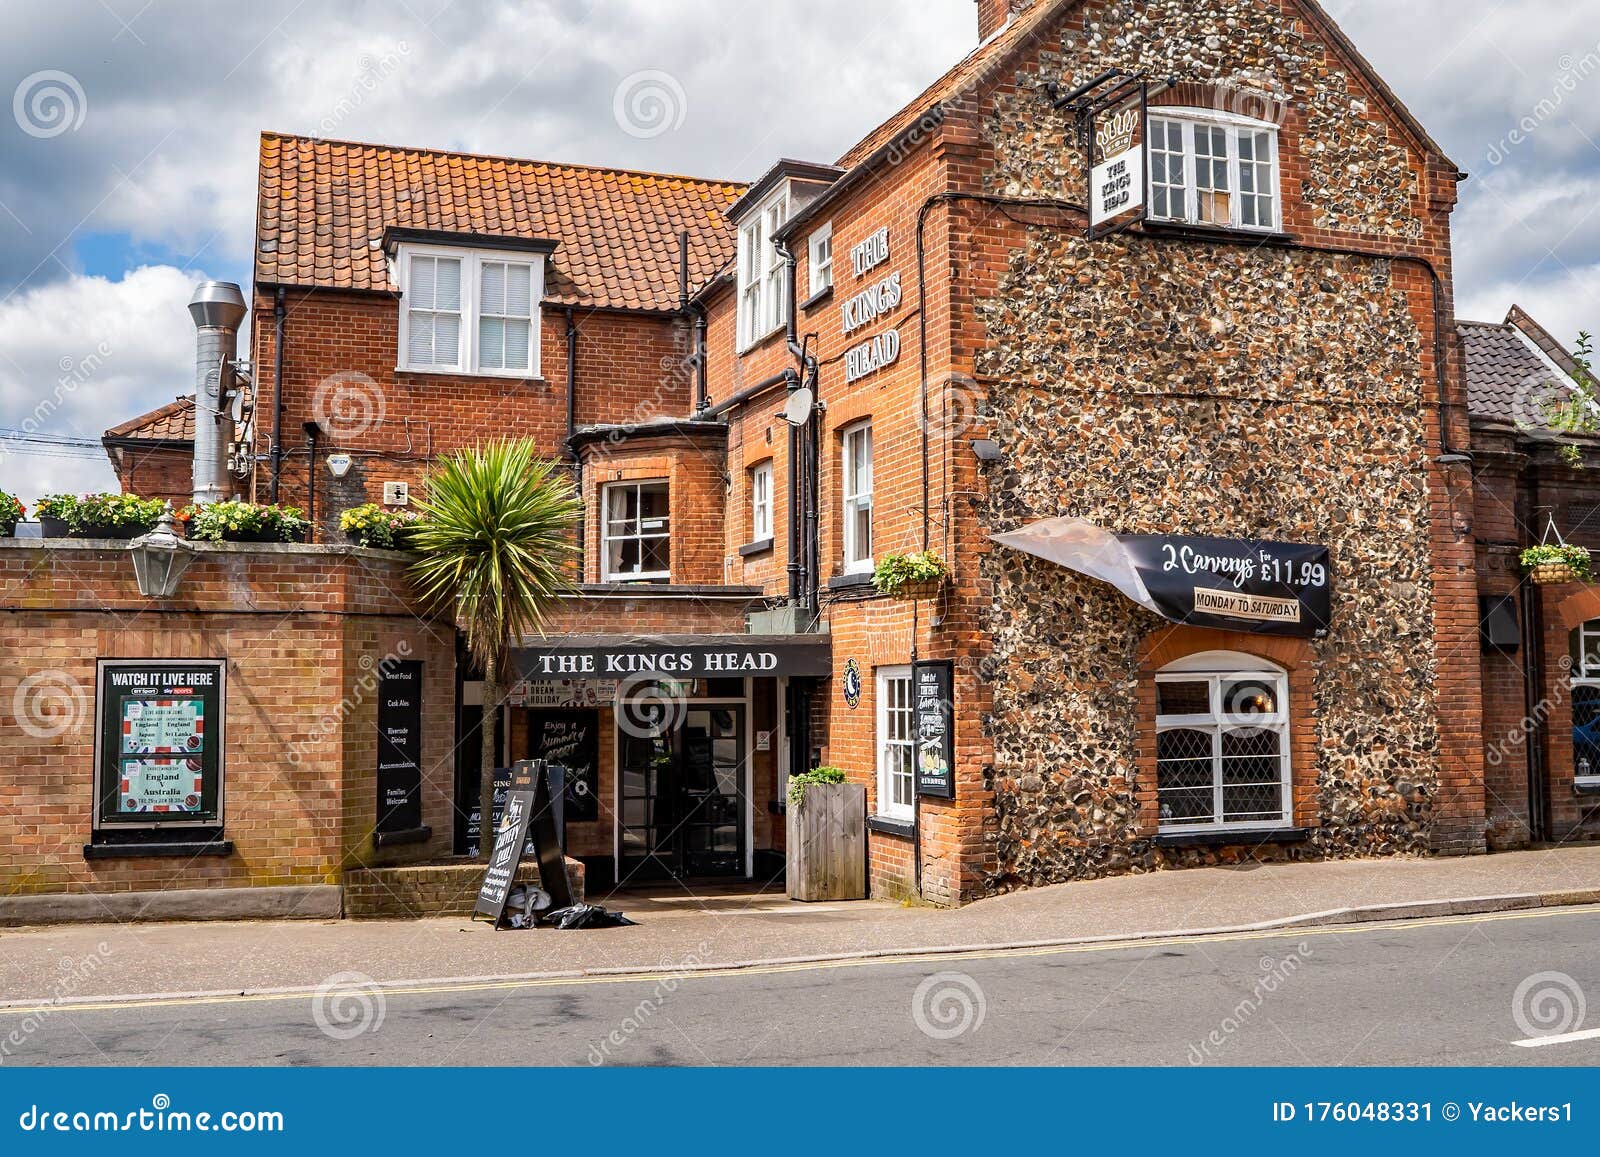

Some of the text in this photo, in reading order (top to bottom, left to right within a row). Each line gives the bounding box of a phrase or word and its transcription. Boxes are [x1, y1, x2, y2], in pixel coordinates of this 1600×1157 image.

[1106, 160, 1126, 178] THE
[1102, 173, 1131, 197] KINGS
[1104, 191, 1129, 213] HEAD
[851, 226, 889, 279] THE
[842, 271, 902, 334] KINGS
[845, 329, 900, 383] HEAD
[1162, 544, 1178, 571] 2
[1180, 545, 1257, 588] Carverys
[1261, 558, 1325, 587] £11.99
[1196, 593, 1298, 616] MONDAY TO SATURDAY
[539, 652, 777, 673] THE KINGS HEAD
[112, 672, 213, 686] WATCH IT LIVE HERE
[531, 686, 554, 694] DREAM
[531, 696, 560, 704] HOLIDAY
[544, 722, 566, 734] Enjoy
[391, 736, 406, 744] Dining
